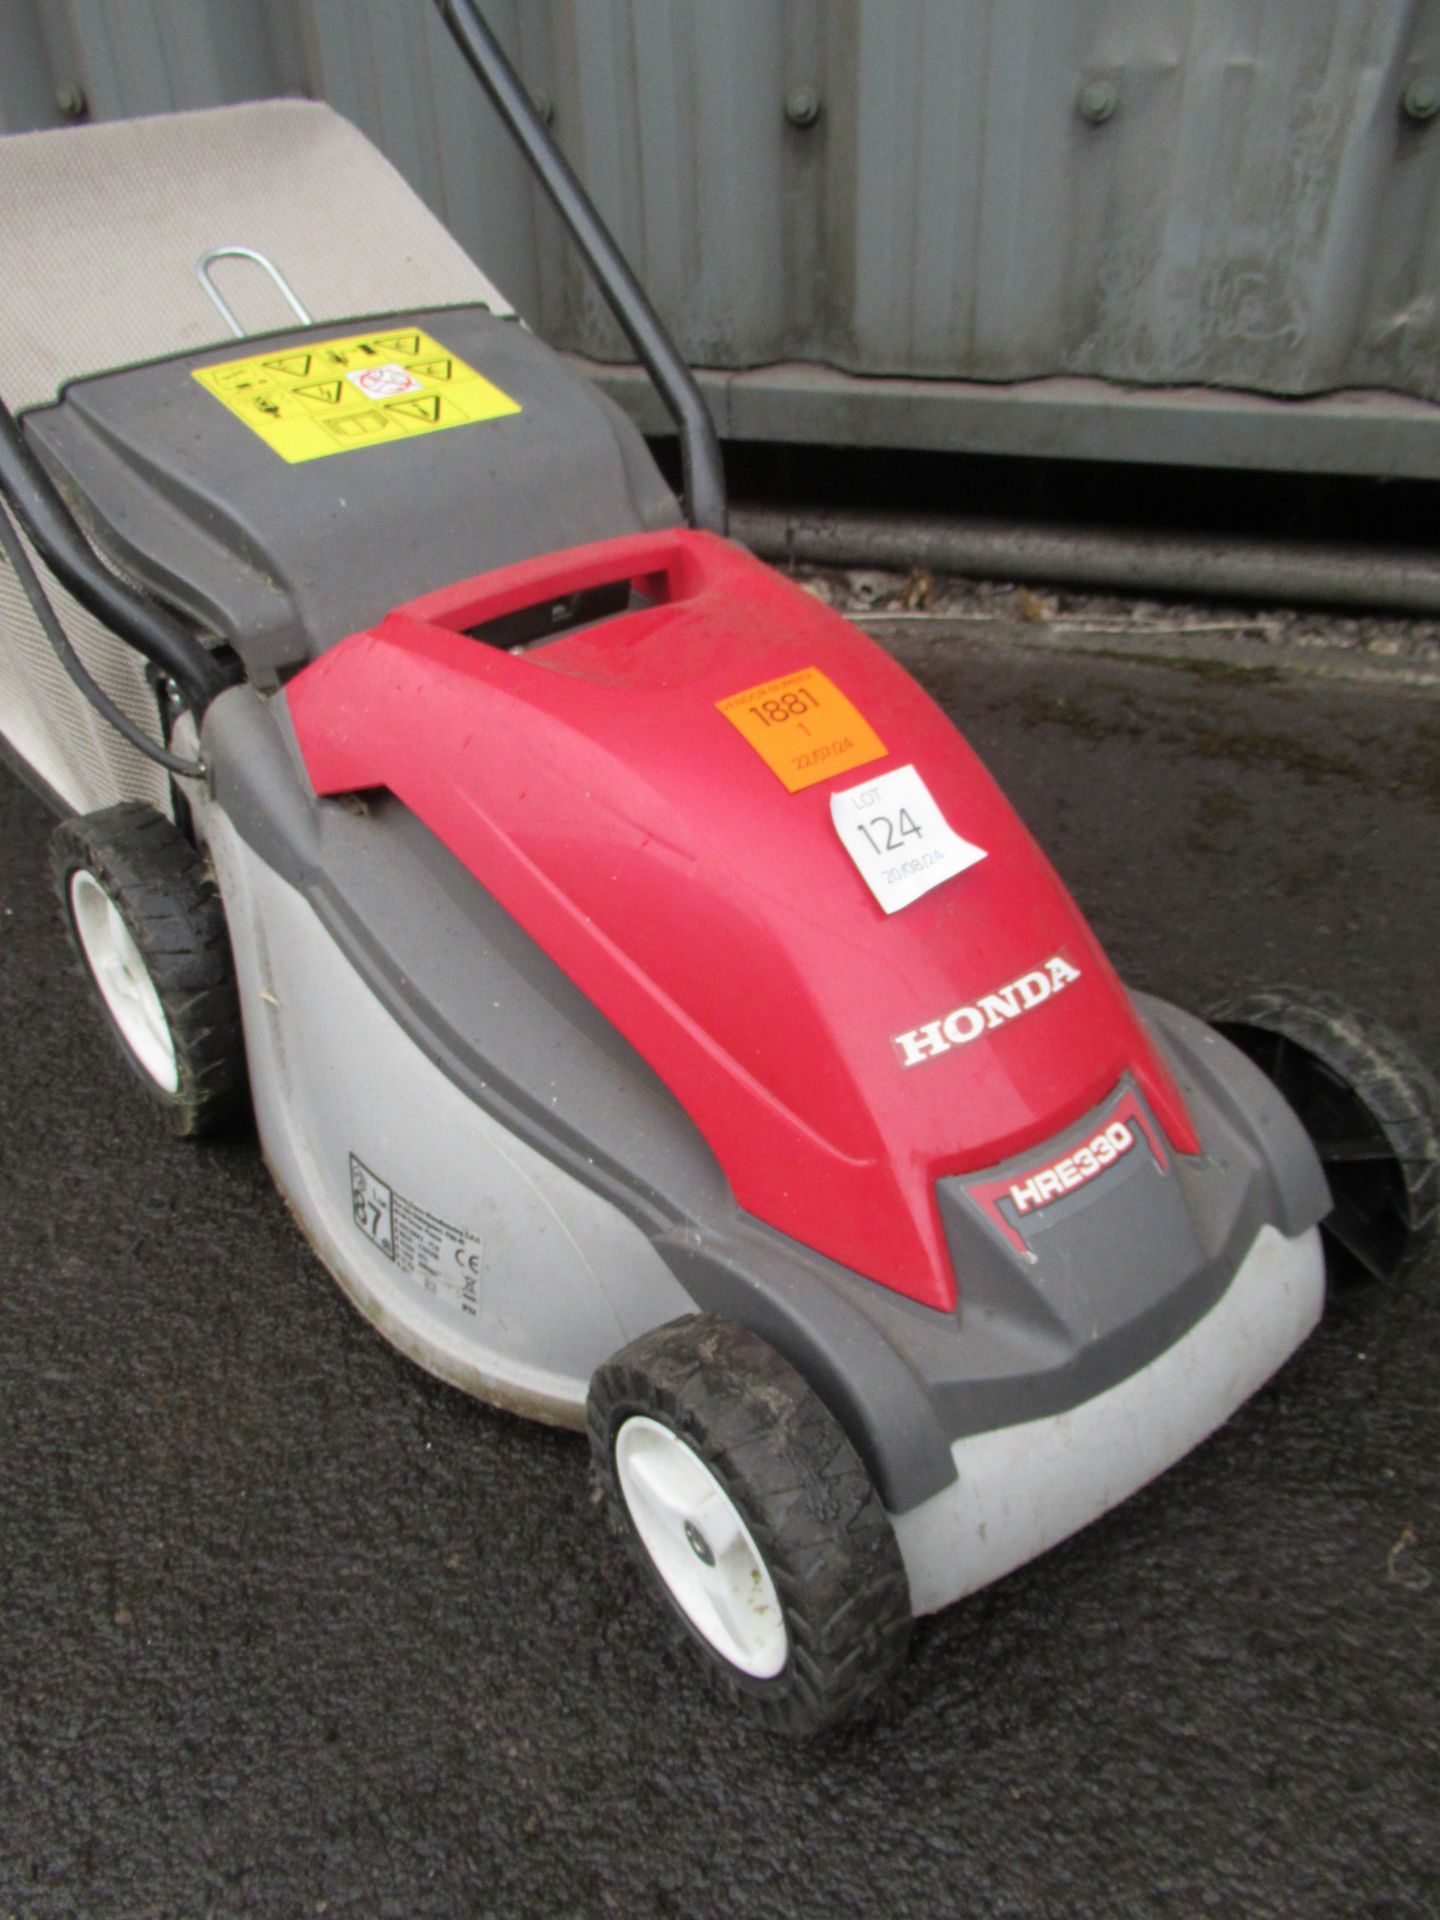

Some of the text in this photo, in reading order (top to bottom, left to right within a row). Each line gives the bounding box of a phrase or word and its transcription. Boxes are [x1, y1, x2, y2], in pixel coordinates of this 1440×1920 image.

[749, 687, 820, 727] 1881
[798, 723, 811, 737] 1
[794, 738, 854, 770] 22/07/24
[852, 788, 883, 810] LOT
[856, 807, 923, 855] 124
[882, 851, 945, 885] 20/08/24
[895, 956, 1082, 1066] HONDA
[1009, 1121, 1134, 1213] HRE330
